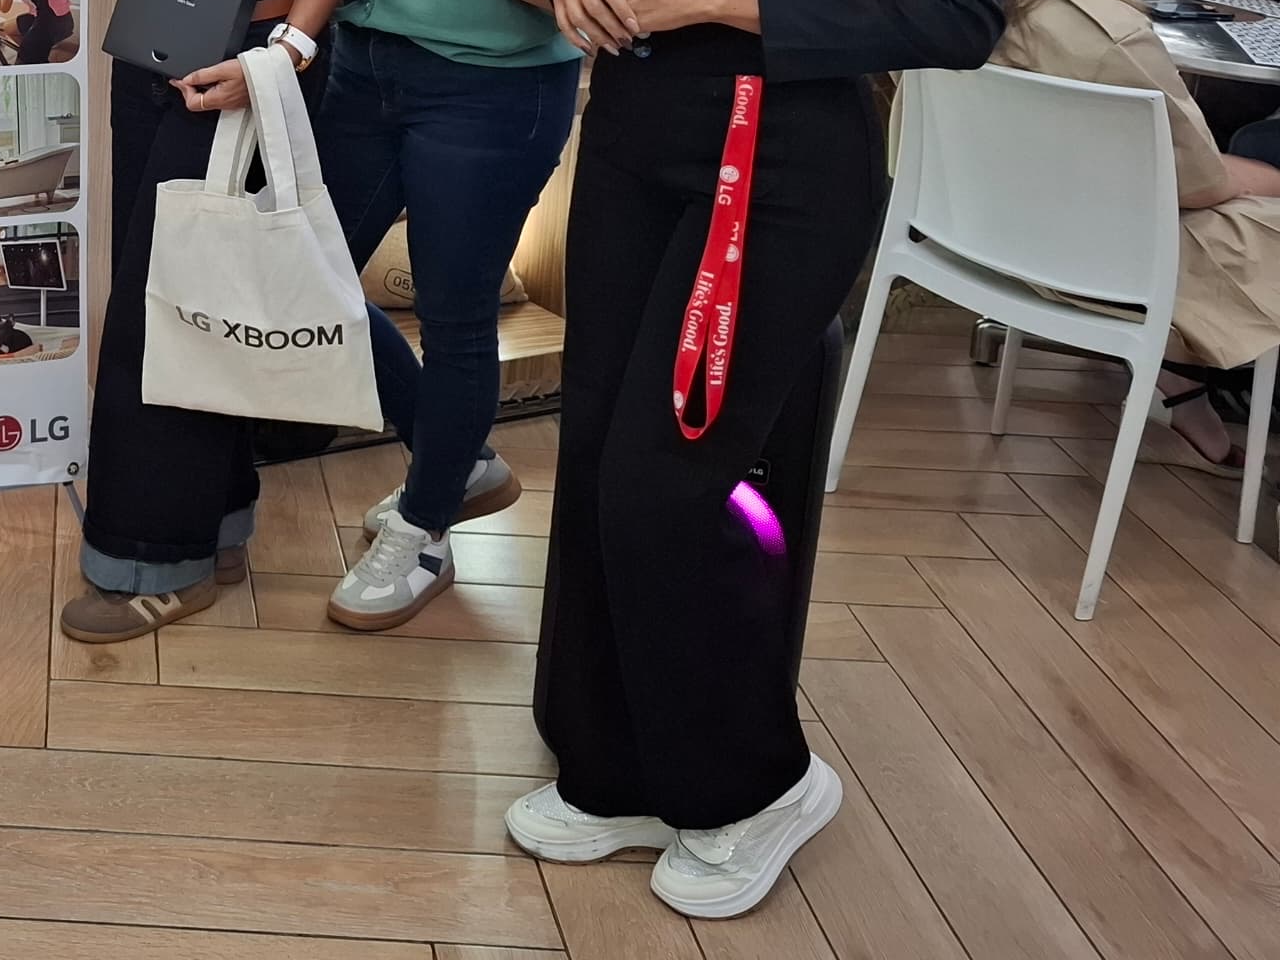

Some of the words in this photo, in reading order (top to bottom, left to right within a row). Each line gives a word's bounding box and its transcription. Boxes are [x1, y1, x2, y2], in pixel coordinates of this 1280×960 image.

[732, 84, 754, 128] Good.
[718, 185, 734, 206] LG
[692, 270, 715, 307] Life's
[175, 305, 211, 333] LG
[222, 318, 344, 350] XBOOM
[681, 309, 704, 353] Good.
[713, 302, 732, 346] Good.
[709, 347, 727, 386] Life's
[30, 415, 70, 444] LG
